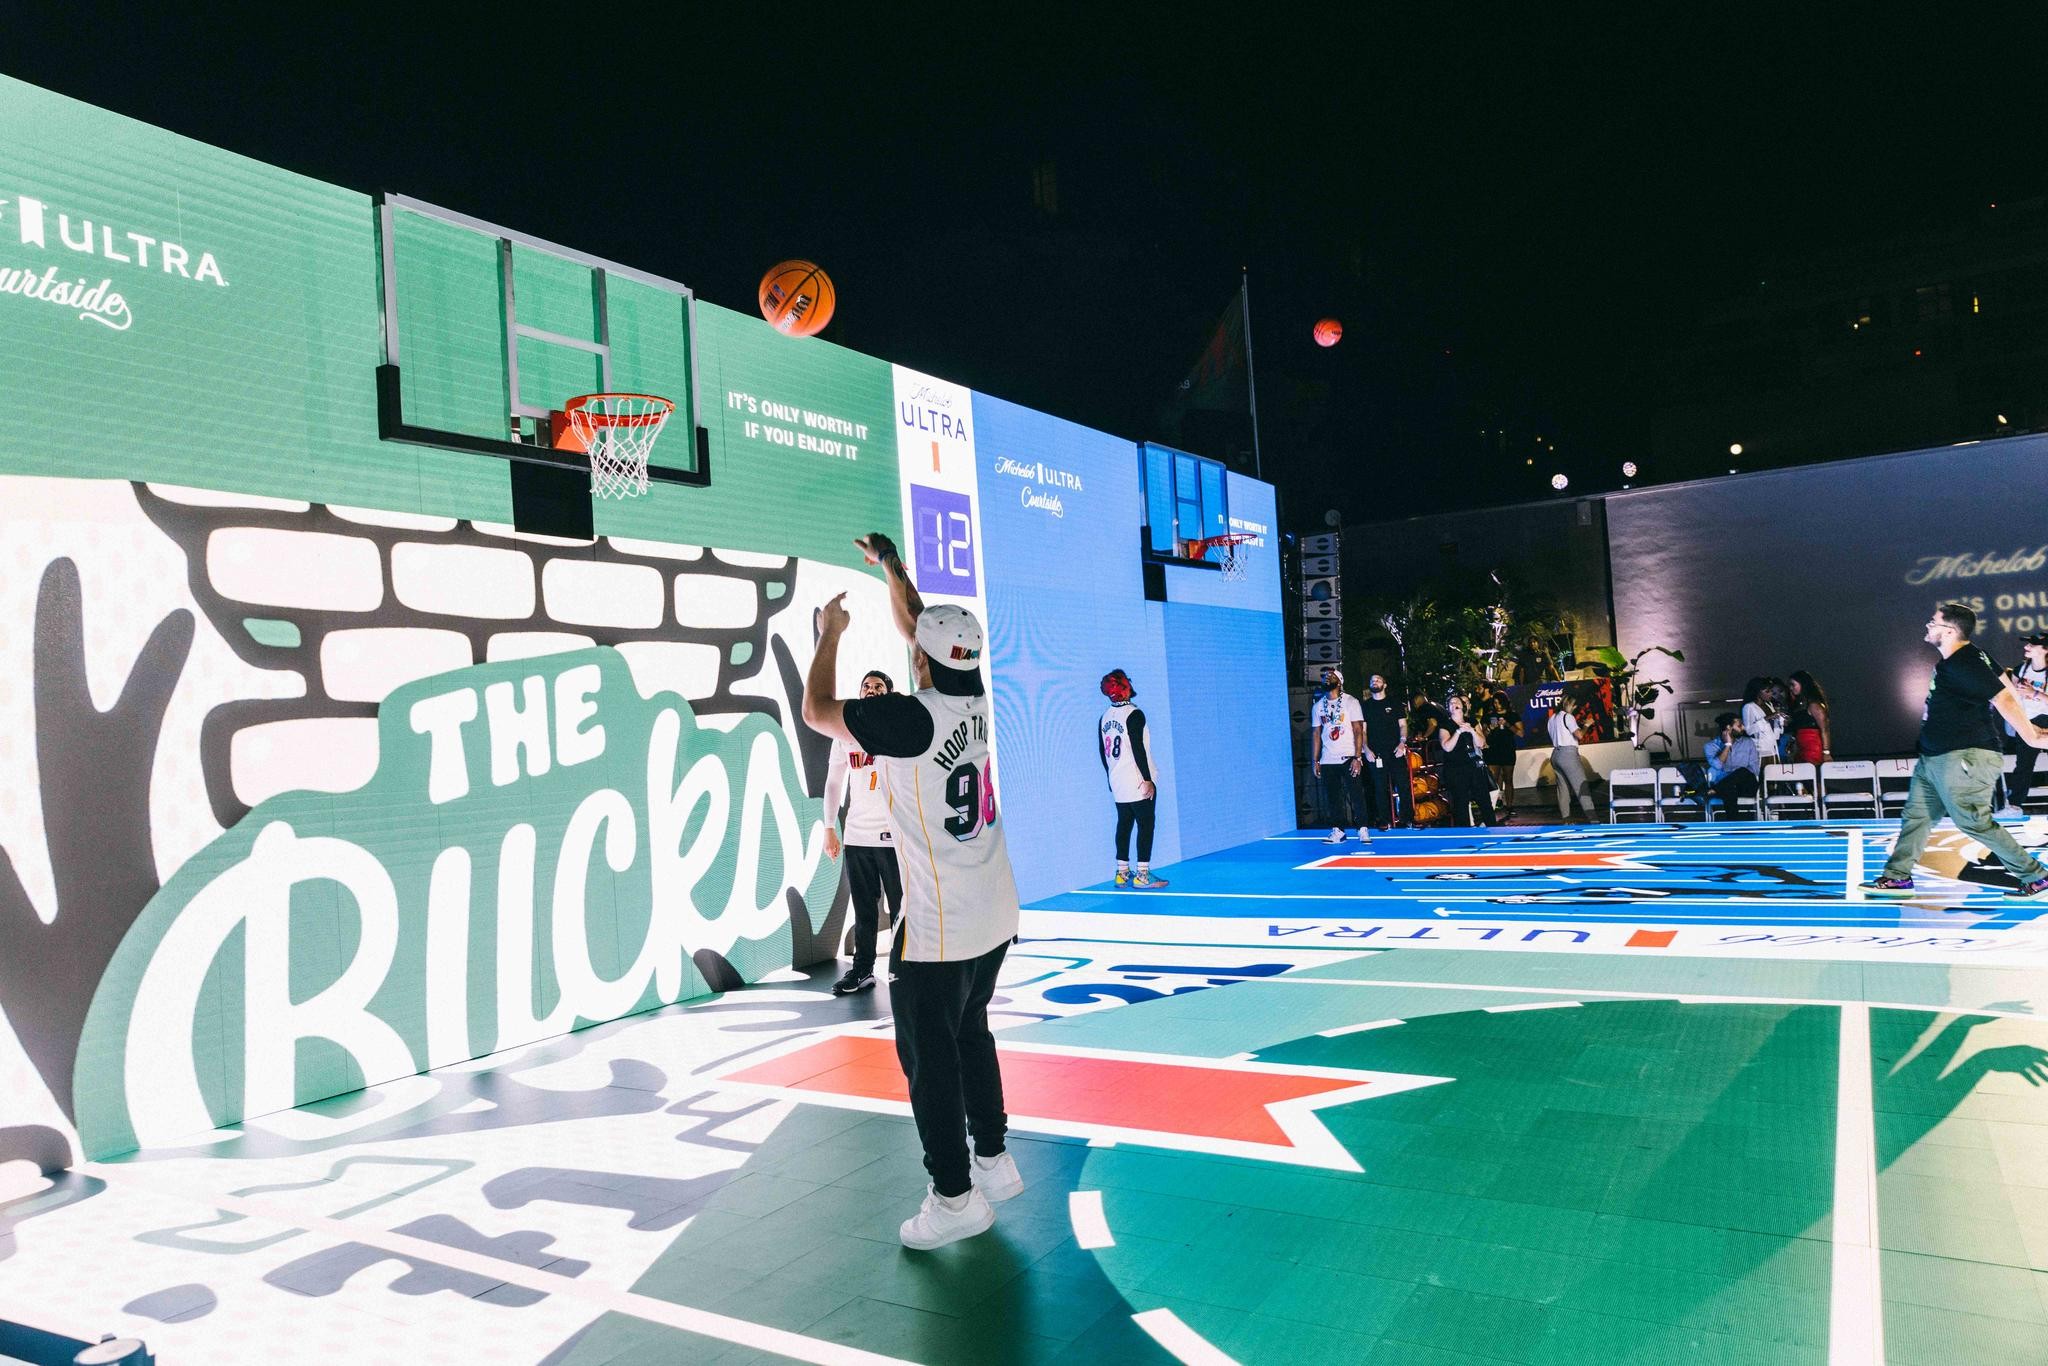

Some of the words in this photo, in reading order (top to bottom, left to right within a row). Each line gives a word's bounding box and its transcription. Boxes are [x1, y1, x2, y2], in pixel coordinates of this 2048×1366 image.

[58, 213, 227, 287] ULTRA
[728, 391, 757, 414] IT'S
[761, 400, 800, 423] ONLY
[803, 410, 853, 437] WORTH
[856, 423, 868, 440] IT
[901, 401, 967, 441] ULTRA
[745, 421, 759, 438] IF
[763, 425, 793, 446] YOU
[797, 433, 842, 457] ENJOY
[845, 444, 858, 460] IT
[1045, 467, 1082, 491] ULTRA
[936, 511, 971, 577] 12
[1905, 545, 2048, 585] Michelob
[1530, 697, 1562, 709] ULTR
[409, 663, 606, 805] THE
[933, 720, 969, 772] HOOP
